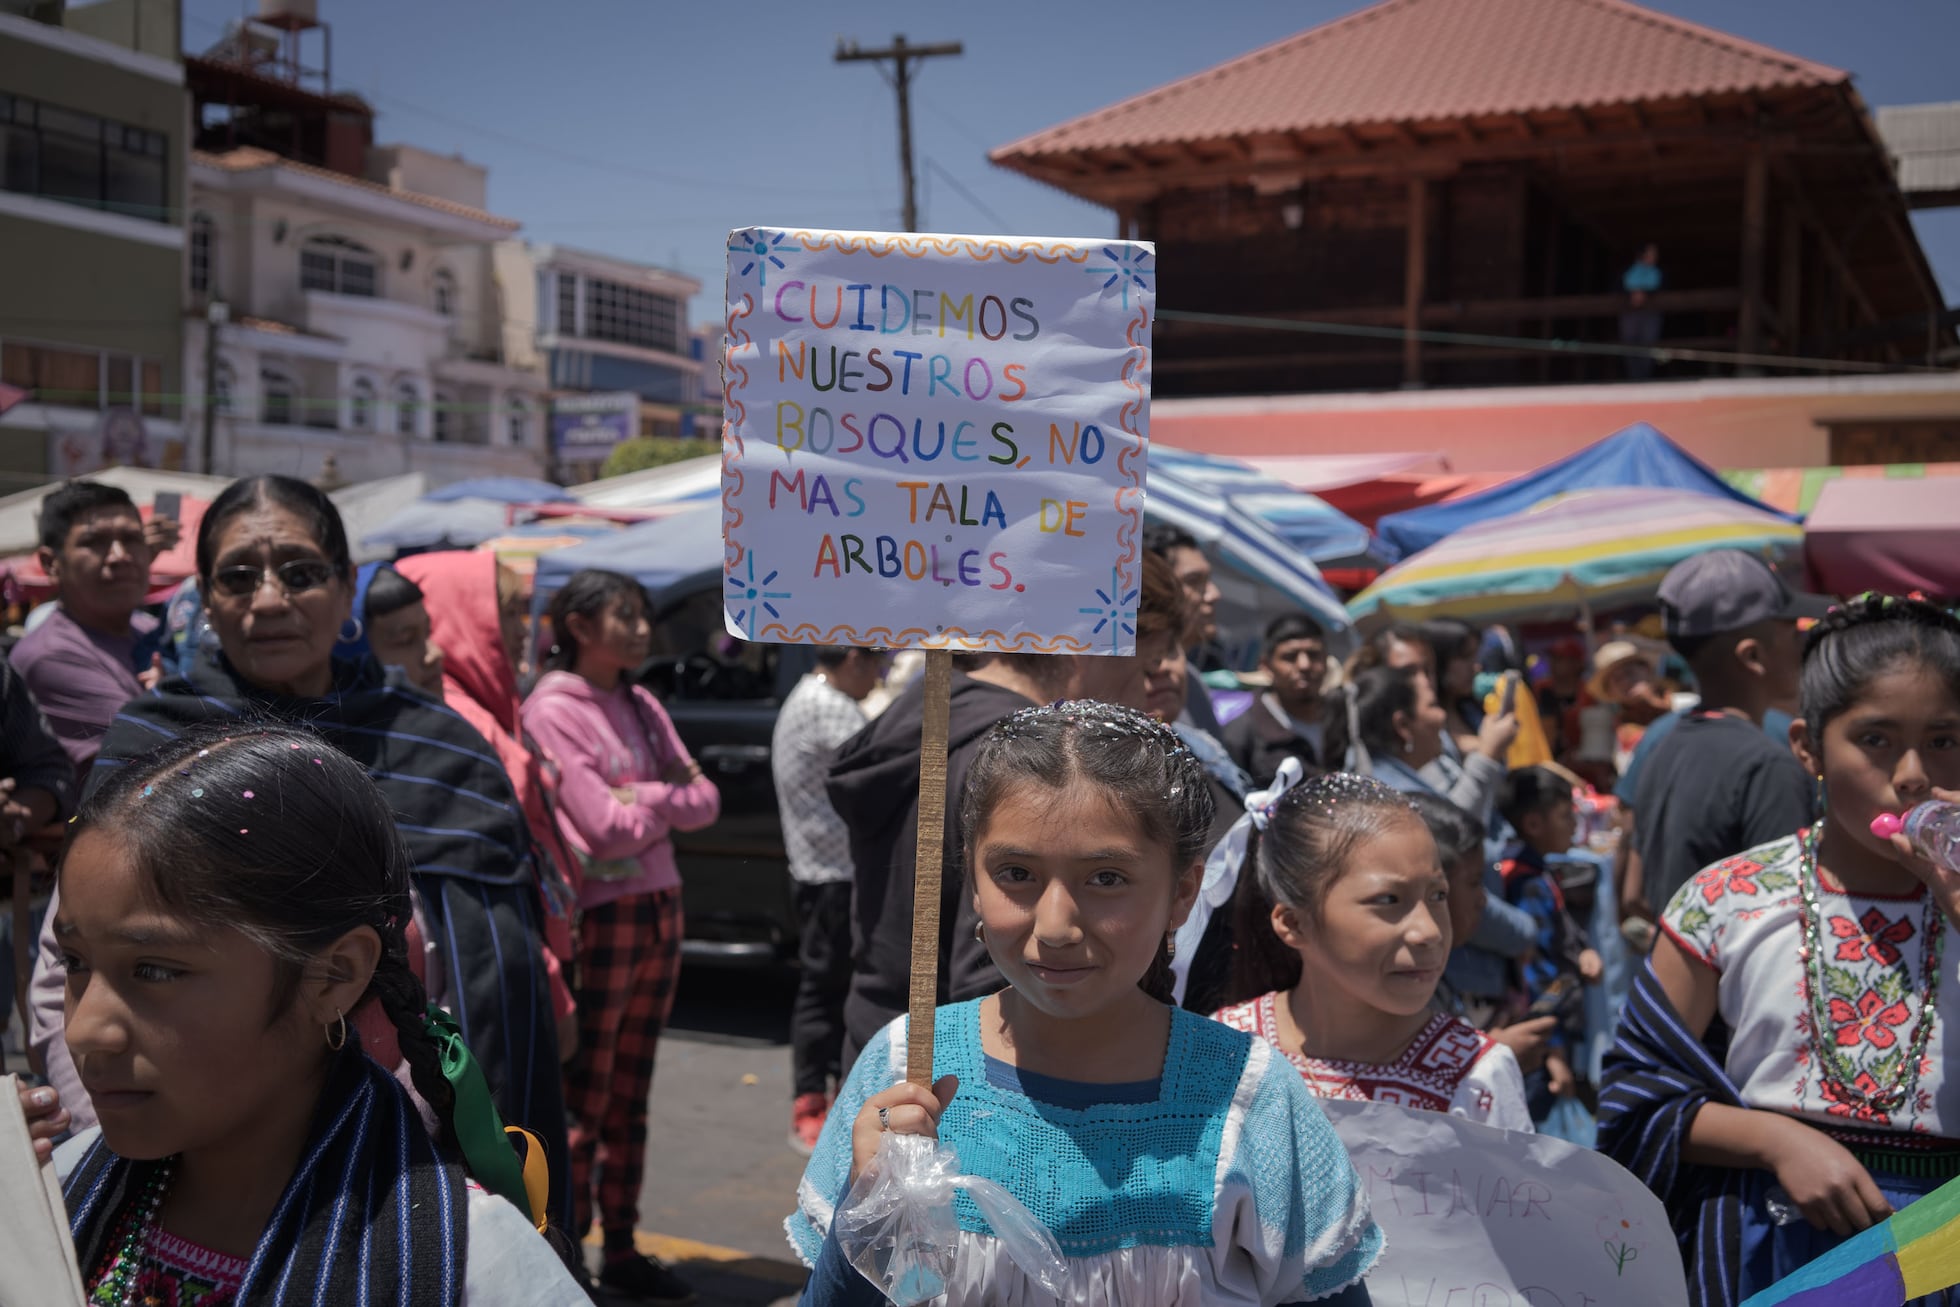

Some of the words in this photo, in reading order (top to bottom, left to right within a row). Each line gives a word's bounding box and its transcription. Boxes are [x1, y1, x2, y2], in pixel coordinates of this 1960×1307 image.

[775, 281, 1040, 341] CUIDEMOS
[778, 341, 1027, 401] NUESTROS
[777, 402, 1031, 469] BOSQUES,
[1048, 422, 1105, 465] NO
[769, 469, 866, 517] MAS
[896, 481, 1007, 529] TALA
[1039, 498, 1088, 537] DE
[813, 533, 1026, 592] ARBOLES.
[1357, 1163, 1552, 1221] MINAR
